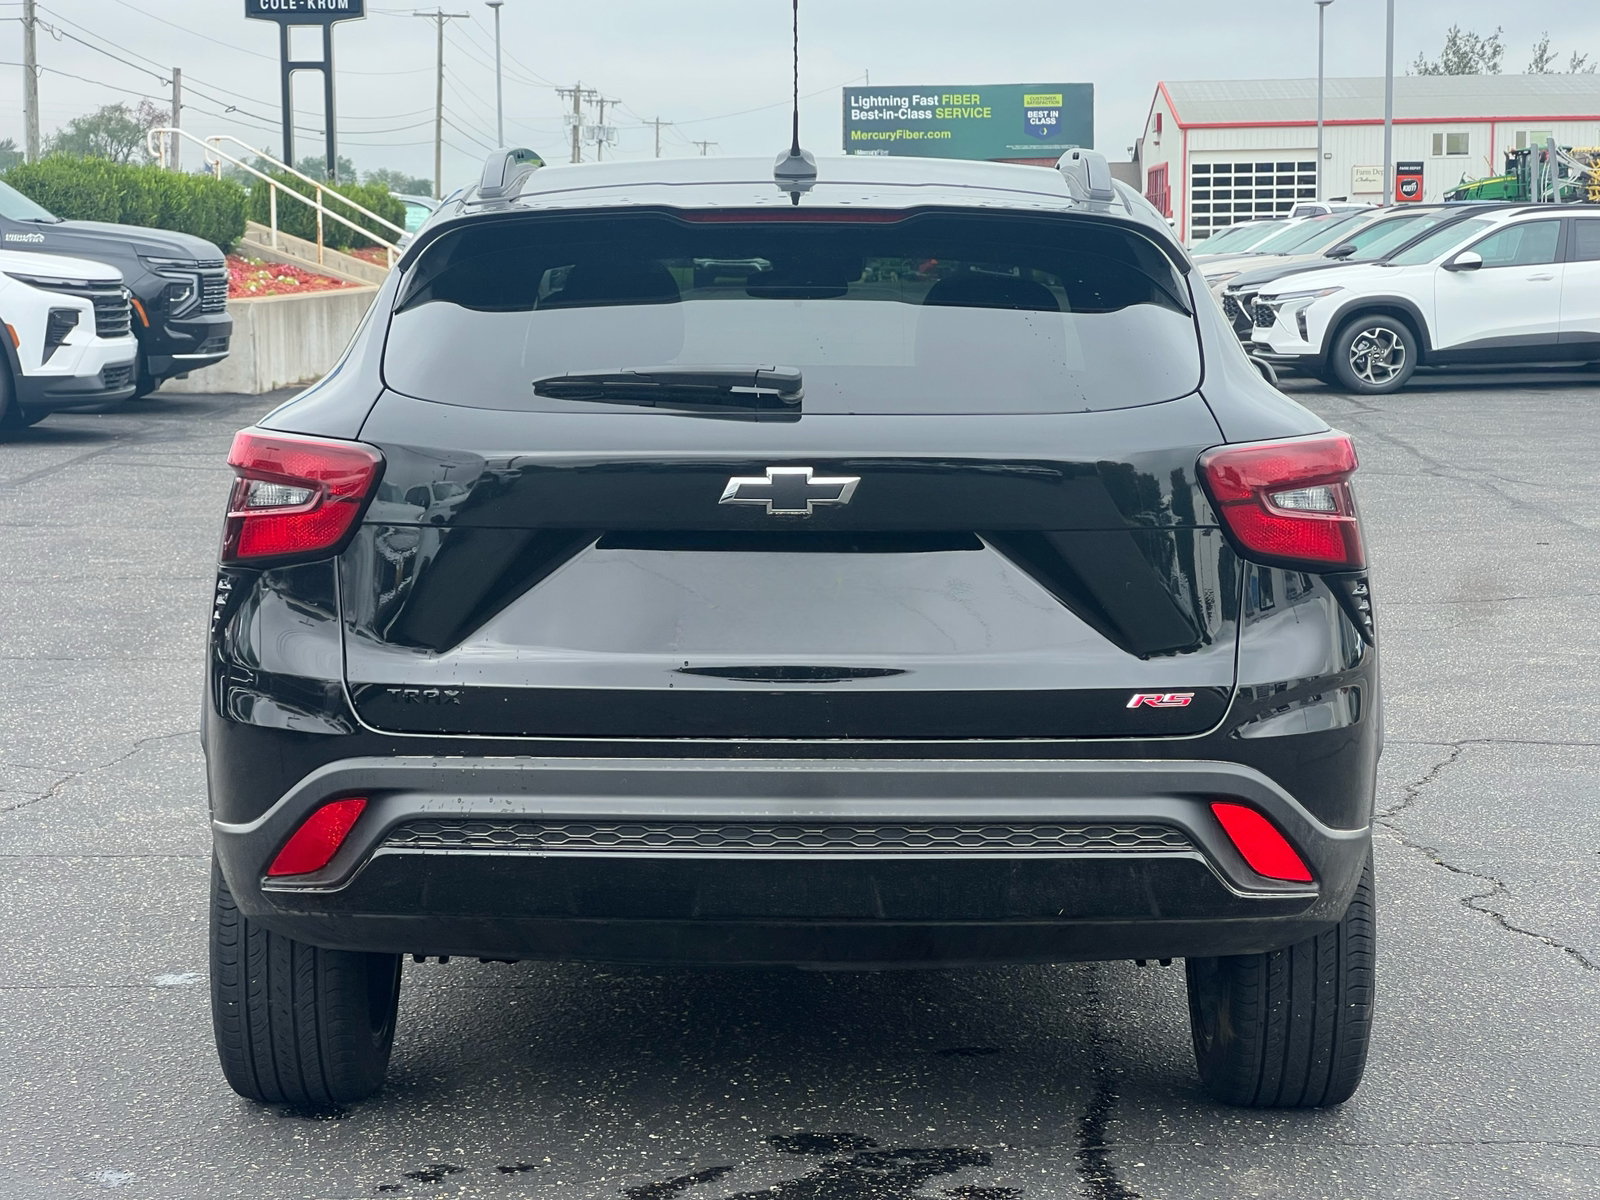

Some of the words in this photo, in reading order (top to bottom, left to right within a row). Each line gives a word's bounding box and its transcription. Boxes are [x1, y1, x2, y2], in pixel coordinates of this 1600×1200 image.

[260, 0, 349, 9] COLE-KRUM
[850, 95, 909, 109] Lightning
[912, 94, 939, 106] Fast
[942, 94, 980, 105] FIBER
[851, 108, 933, 120] Best-in-Class
[935, 107, 992, 119] SERVICE
[1027, 110, 1049, 119] BEST
[1050, 110, 1059, 118] IN
[1030, 117, 1057, 125] CLASS
[851, 129, 952, 141] MercuryFiber.com
[386, 688, 461, 705] TRAX
[1126, 692, 1195, 708] RS
